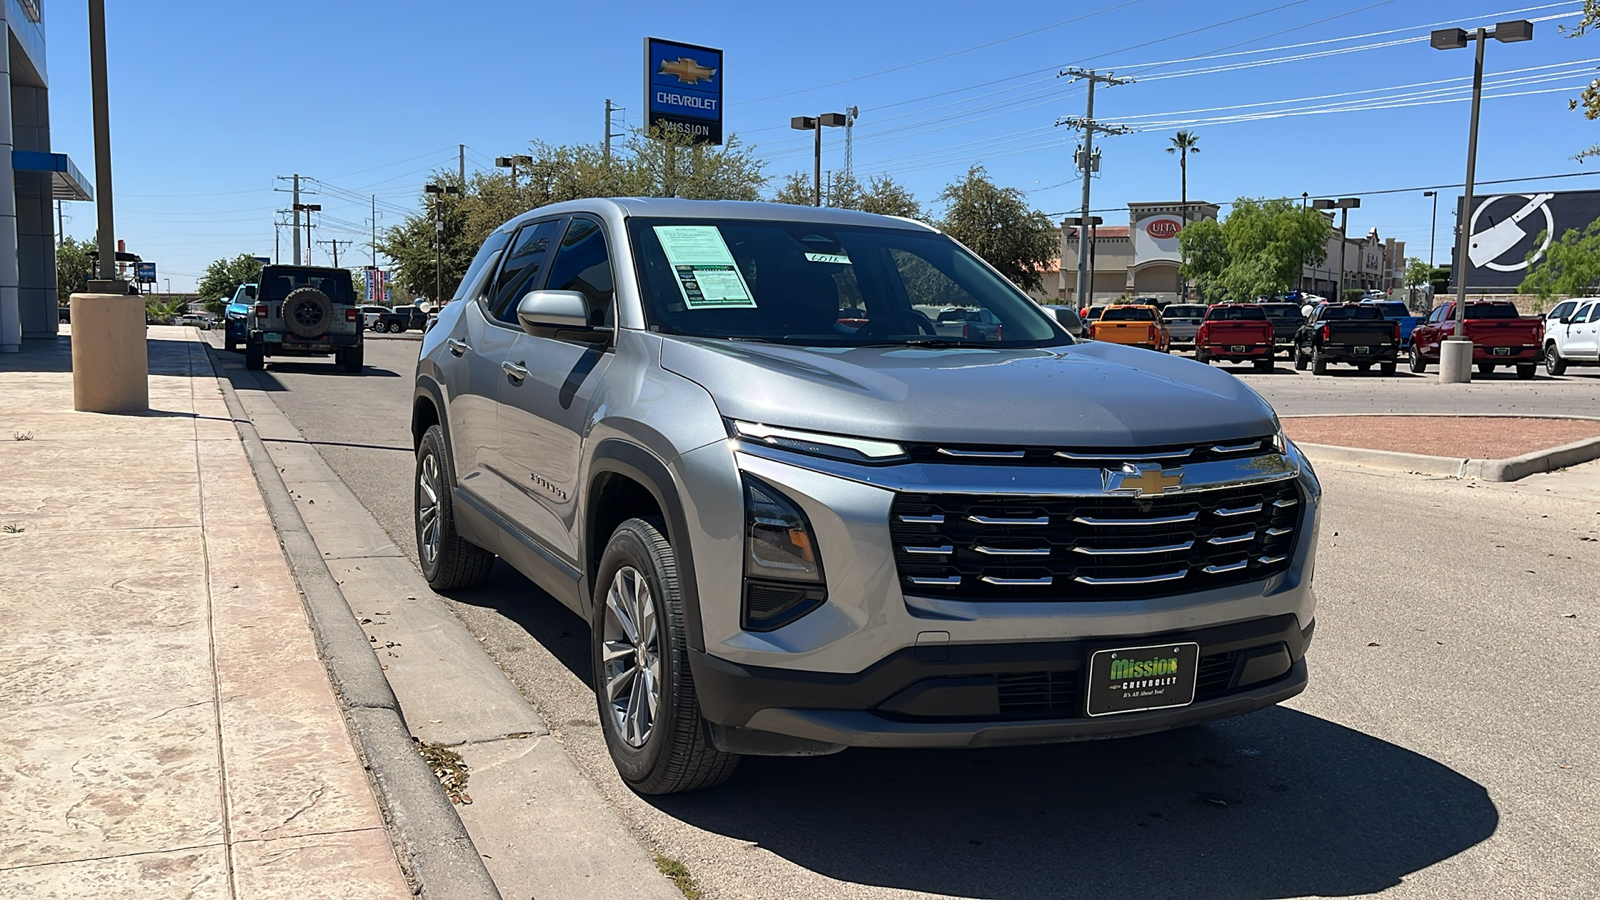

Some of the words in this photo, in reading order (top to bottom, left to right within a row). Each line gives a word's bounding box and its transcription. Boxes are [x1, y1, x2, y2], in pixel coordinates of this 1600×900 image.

[657, 92, 717, 110] CHEVROLET
[1152, 223, 1177, 232] ULTA
[1110, 657, 1178, 680] Mission
[1122, 677, 1177, 689] CHEVROLET
